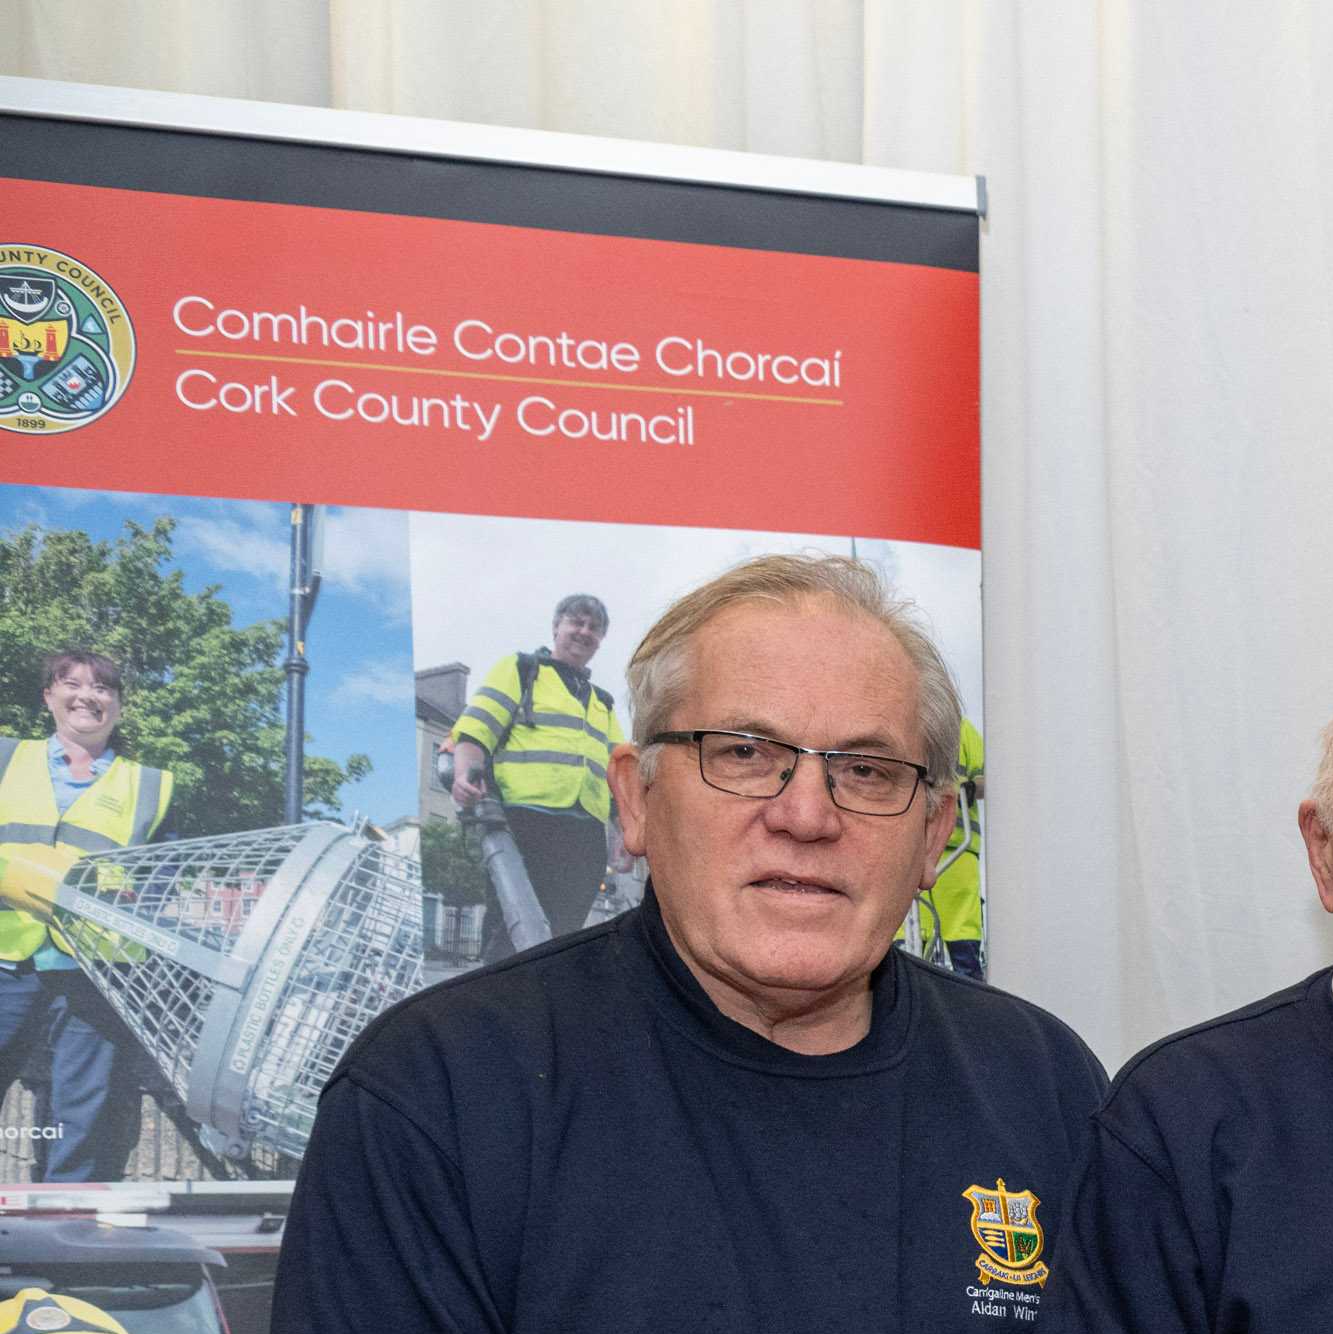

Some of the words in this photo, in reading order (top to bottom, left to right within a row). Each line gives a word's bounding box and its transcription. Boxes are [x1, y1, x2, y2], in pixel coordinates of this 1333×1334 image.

[56, 260, 123, 325] COUNCIL
[172, 295, 438, 356] Comhairle
[453, 319, 641, 373] Contae
[655, 335, 843, 388] Chorcaí
[16, 417, 46, 429] 1899
[175, 368, 298, 417] Cork
[313, 378, 502, 442] County
[516, 395, 695, 446] Council
[966, 1286, 1015, 1301] Carrigaline
[1016, 1291, 1041, 1305] Men's
[971, 1300, 1007, 1317] Aidan
[1013, 1304, 1038, 1321] Win
